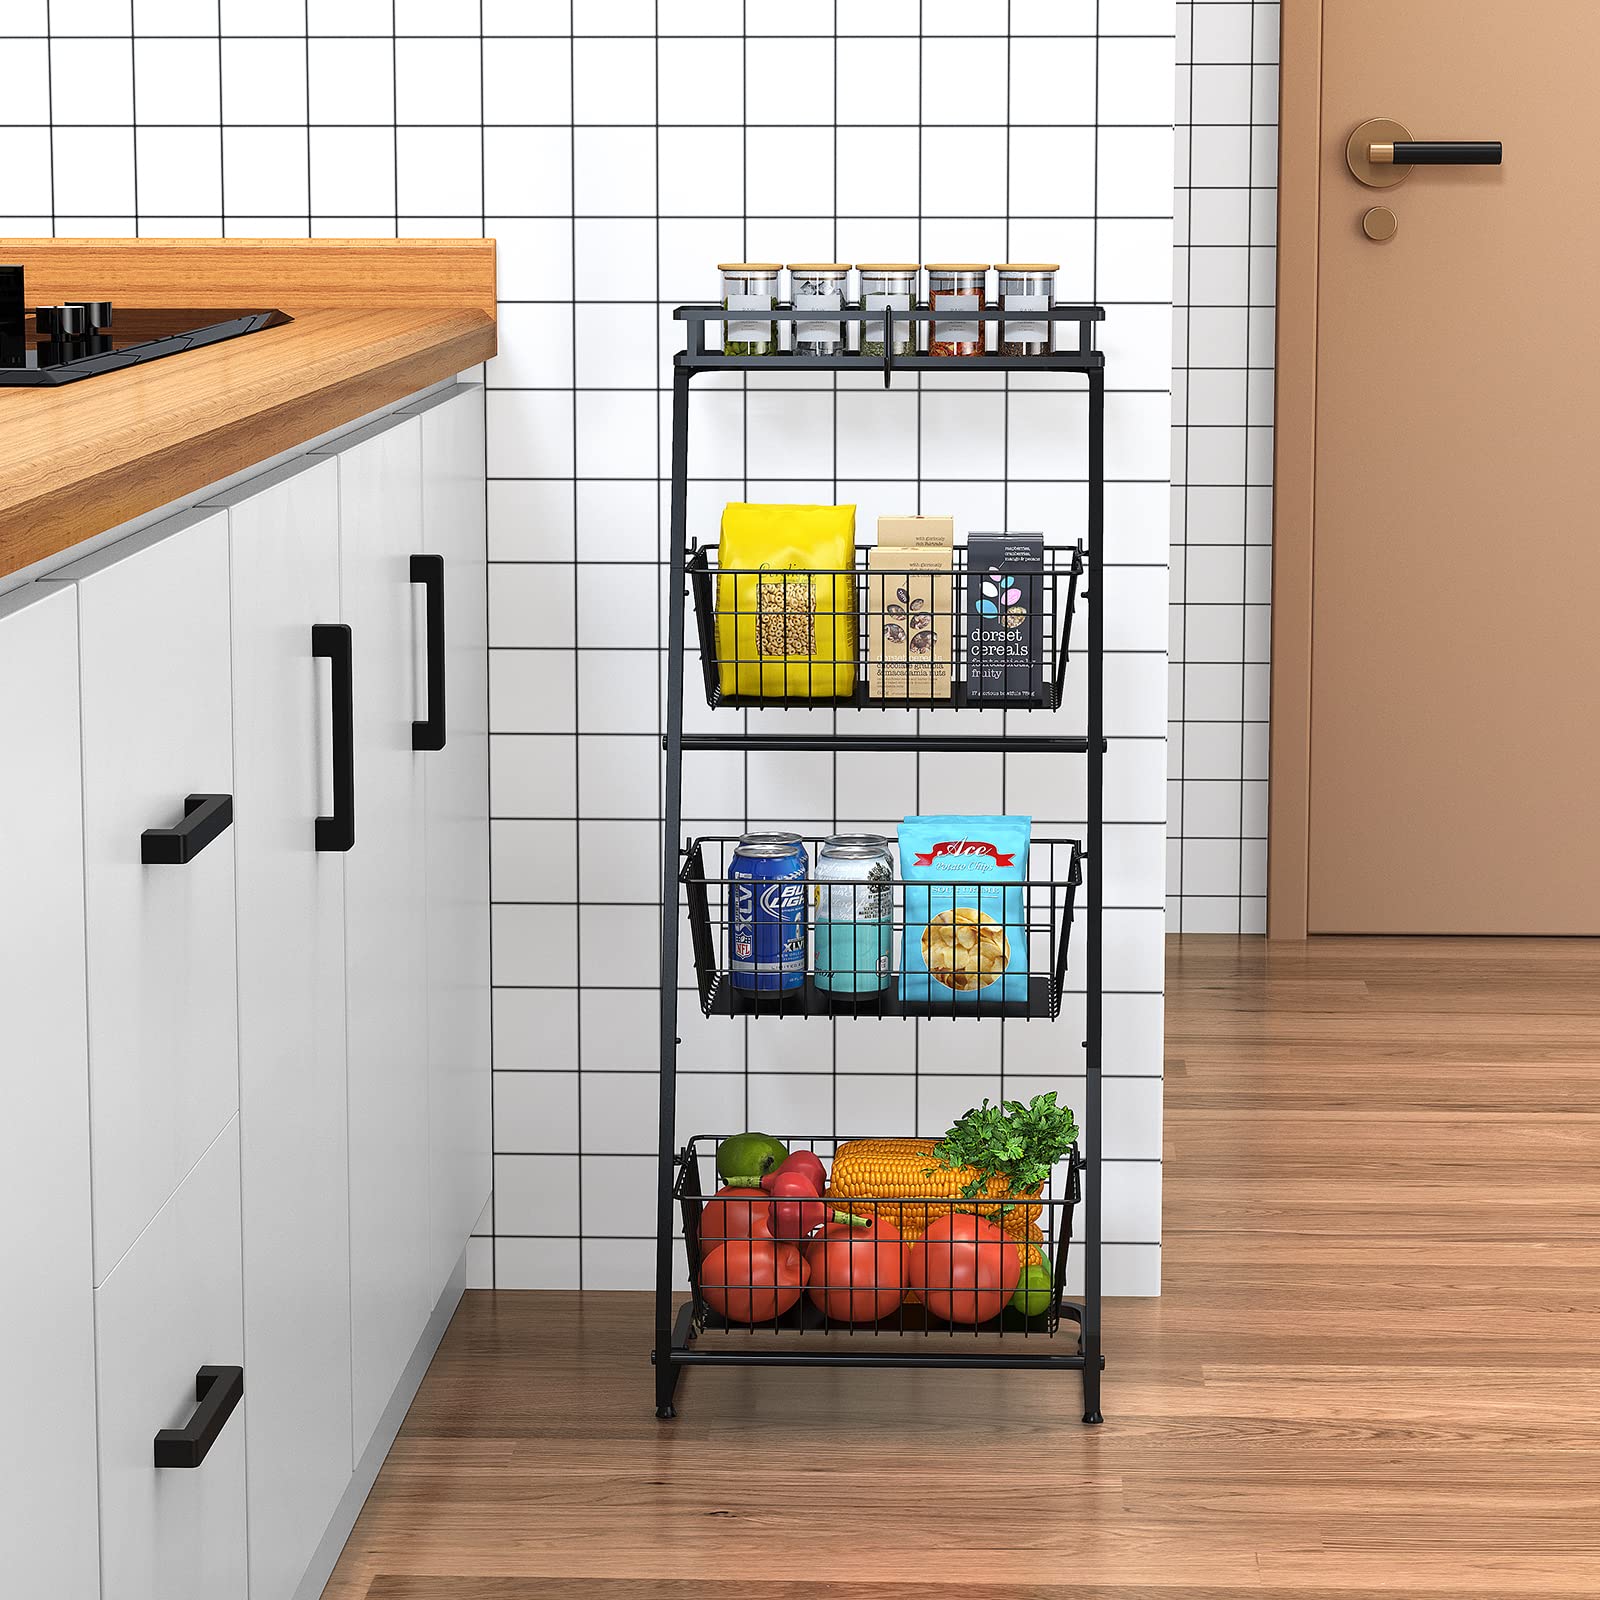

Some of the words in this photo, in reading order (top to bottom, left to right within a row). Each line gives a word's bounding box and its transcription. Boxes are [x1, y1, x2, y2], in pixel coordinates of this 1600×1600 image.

[971, 628, 1023, 642] dorset
[971, 643, 1029, 656] cereals
[971, 657, 1037, 669] fantasticaly
[971, 668, 1003, 680] fruity
[936, 835, 993, 857] Ace
[936, 861, 967, 871] Potato
[967, 860, 994, 874] Chips
[736, 943, 751, 956] NFL
